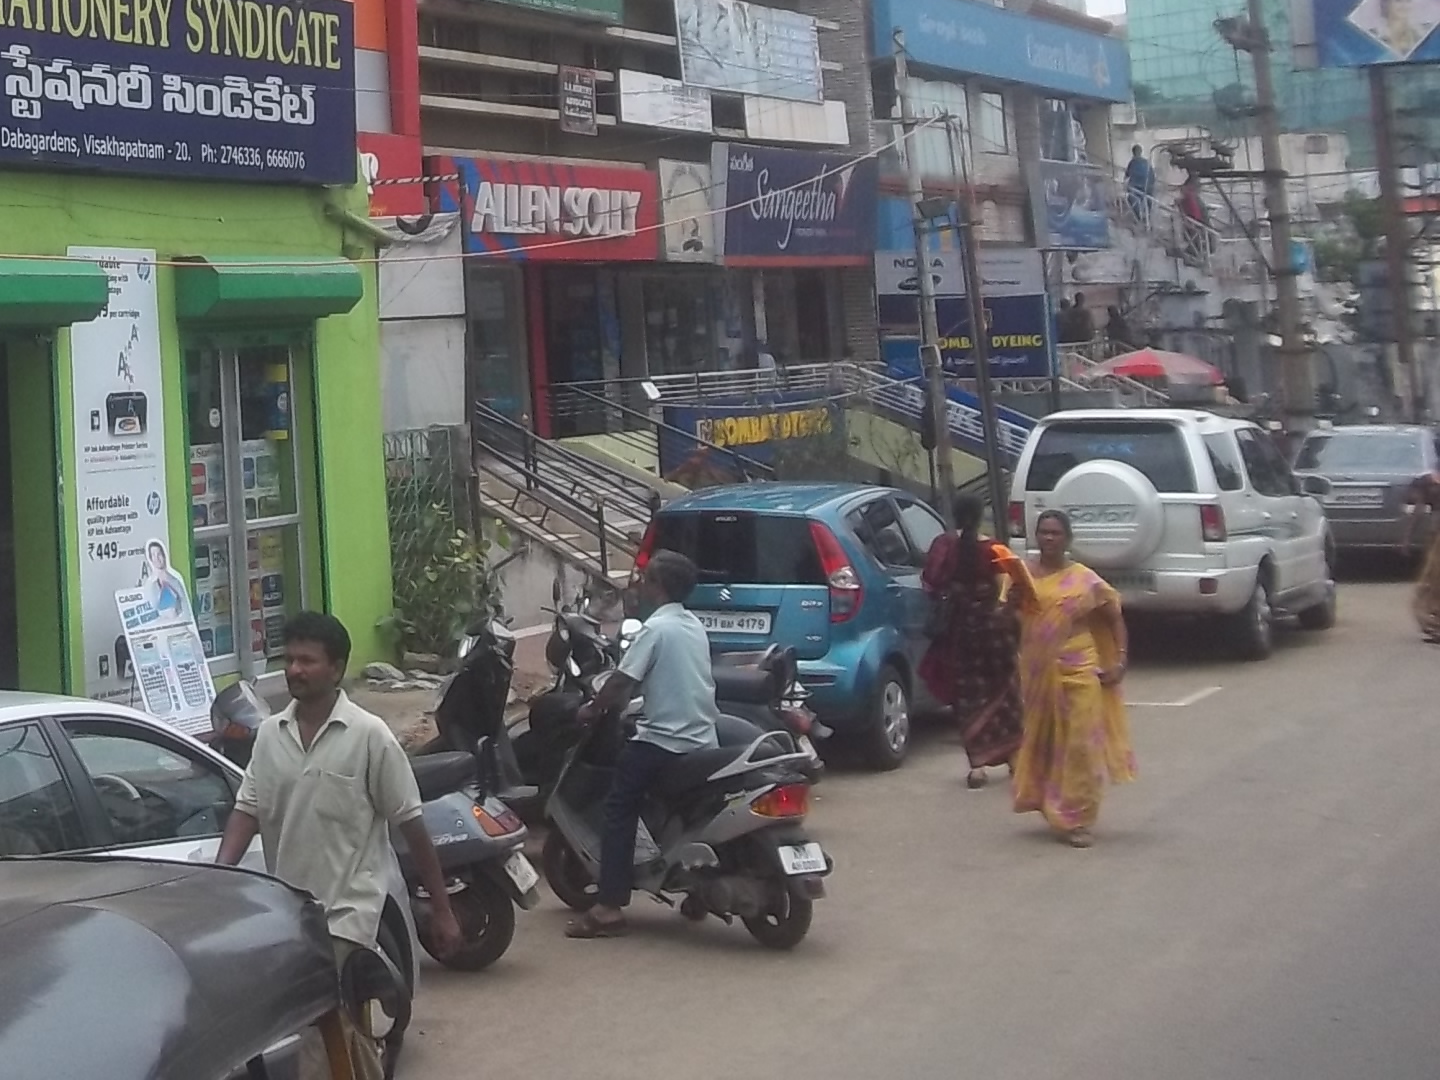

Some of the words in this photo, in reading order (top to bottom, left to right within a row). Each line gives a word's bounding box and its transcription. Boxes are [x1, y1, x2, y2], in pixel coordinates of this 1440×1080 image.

[1, 128, 81, 157] Dabagardens,
[83, 134, 165, 161] Visakhapatnam
[175, 142, 192, 161] 20.
[201, 143, 218, 163] Ph:
[220, 145, 264, 170] 2746336,
[266, 149, 306, 169] 6666076
[471, 181, 561, 234] ALLEN
[562, 187, 642, 237] SOLLY
[750, 163, 837, 250] Sangeetha
[991, 334, 1044, 348] DYEING
[86, 495, 130, 512] Affordable
[737, 618, 766, 631] 4179
